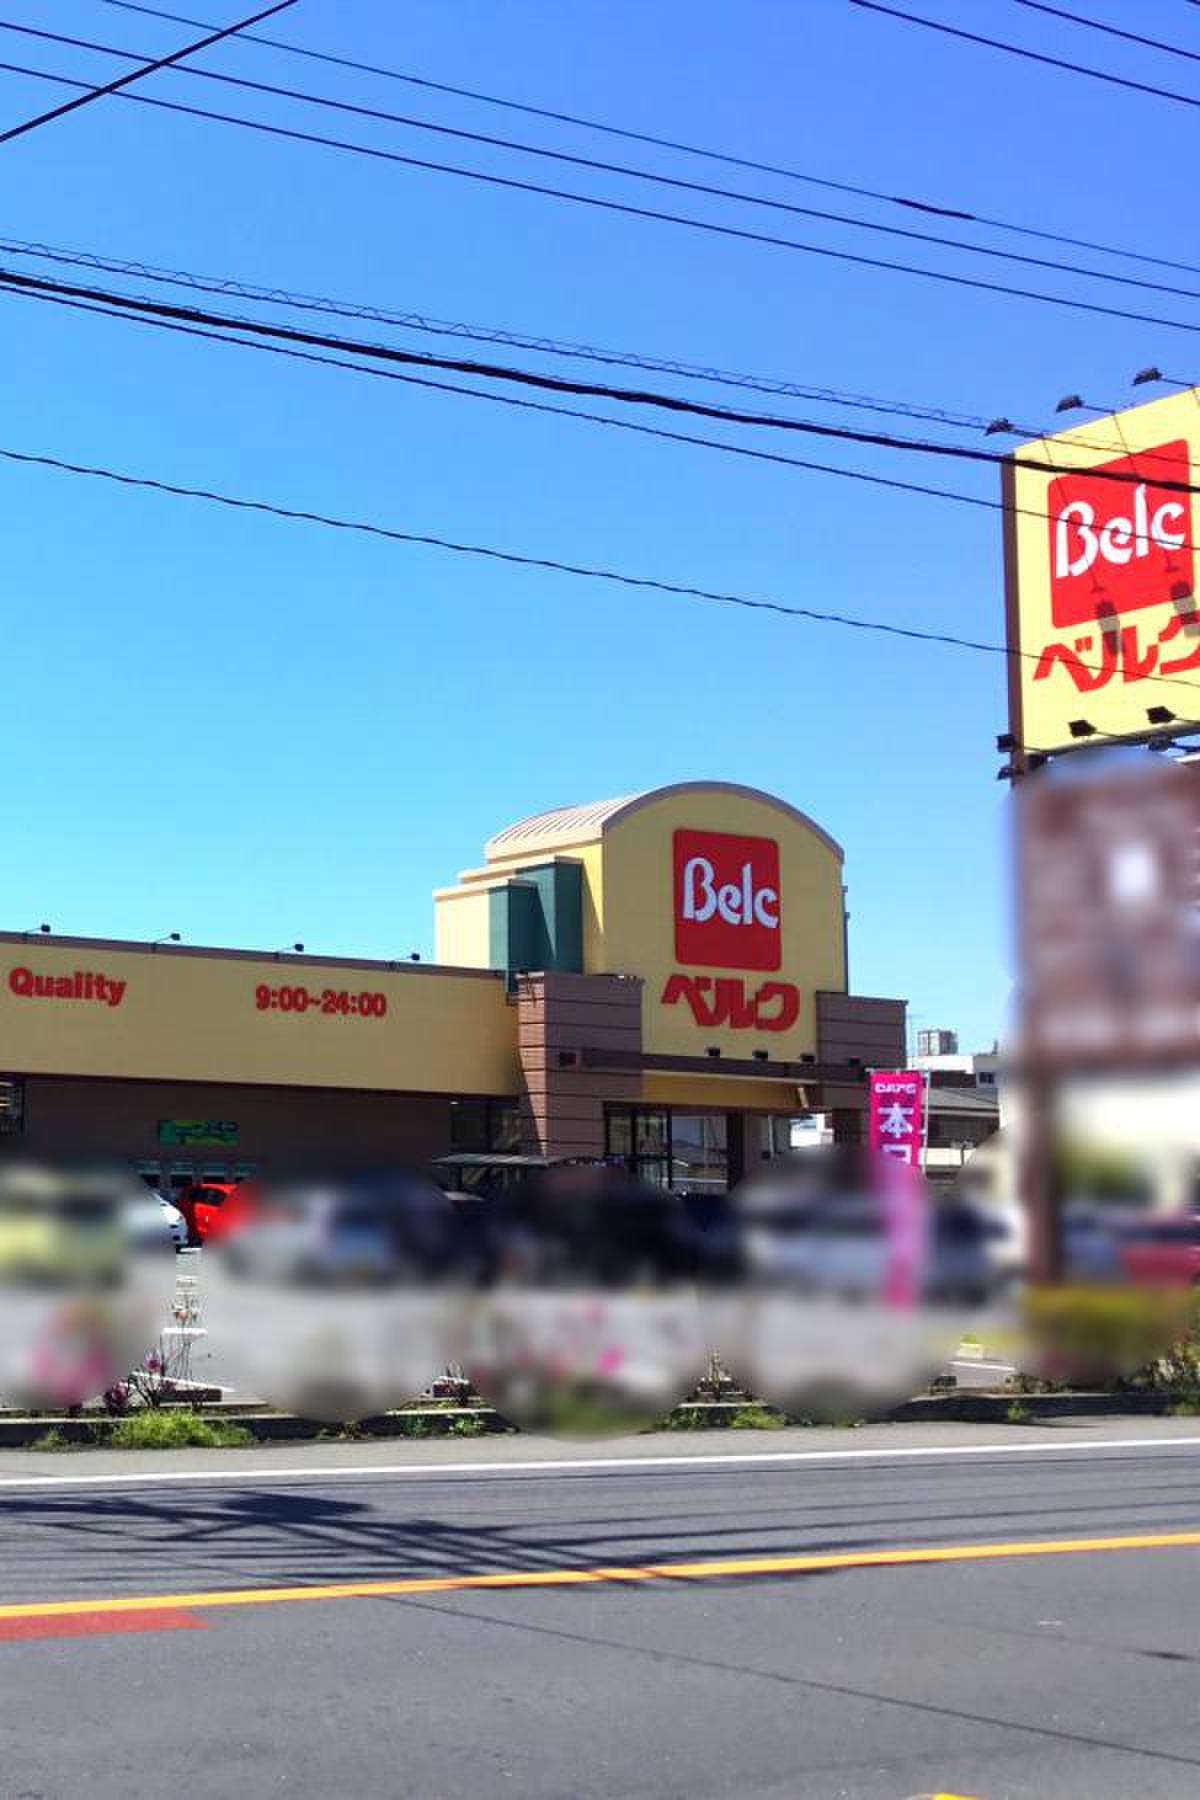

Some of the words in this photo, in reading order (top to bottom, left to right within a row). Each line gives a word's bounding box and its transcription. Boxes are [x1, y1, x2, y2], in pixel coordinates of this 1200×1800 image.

[1055, 483, 1185, 578] Belc
[1032, 608, 1200, 693] ベルク
[682, 857, 780, 929] Belc
[8, 966, 128, 1007] Quality
[661, 973, 800, 1032] ベルク
